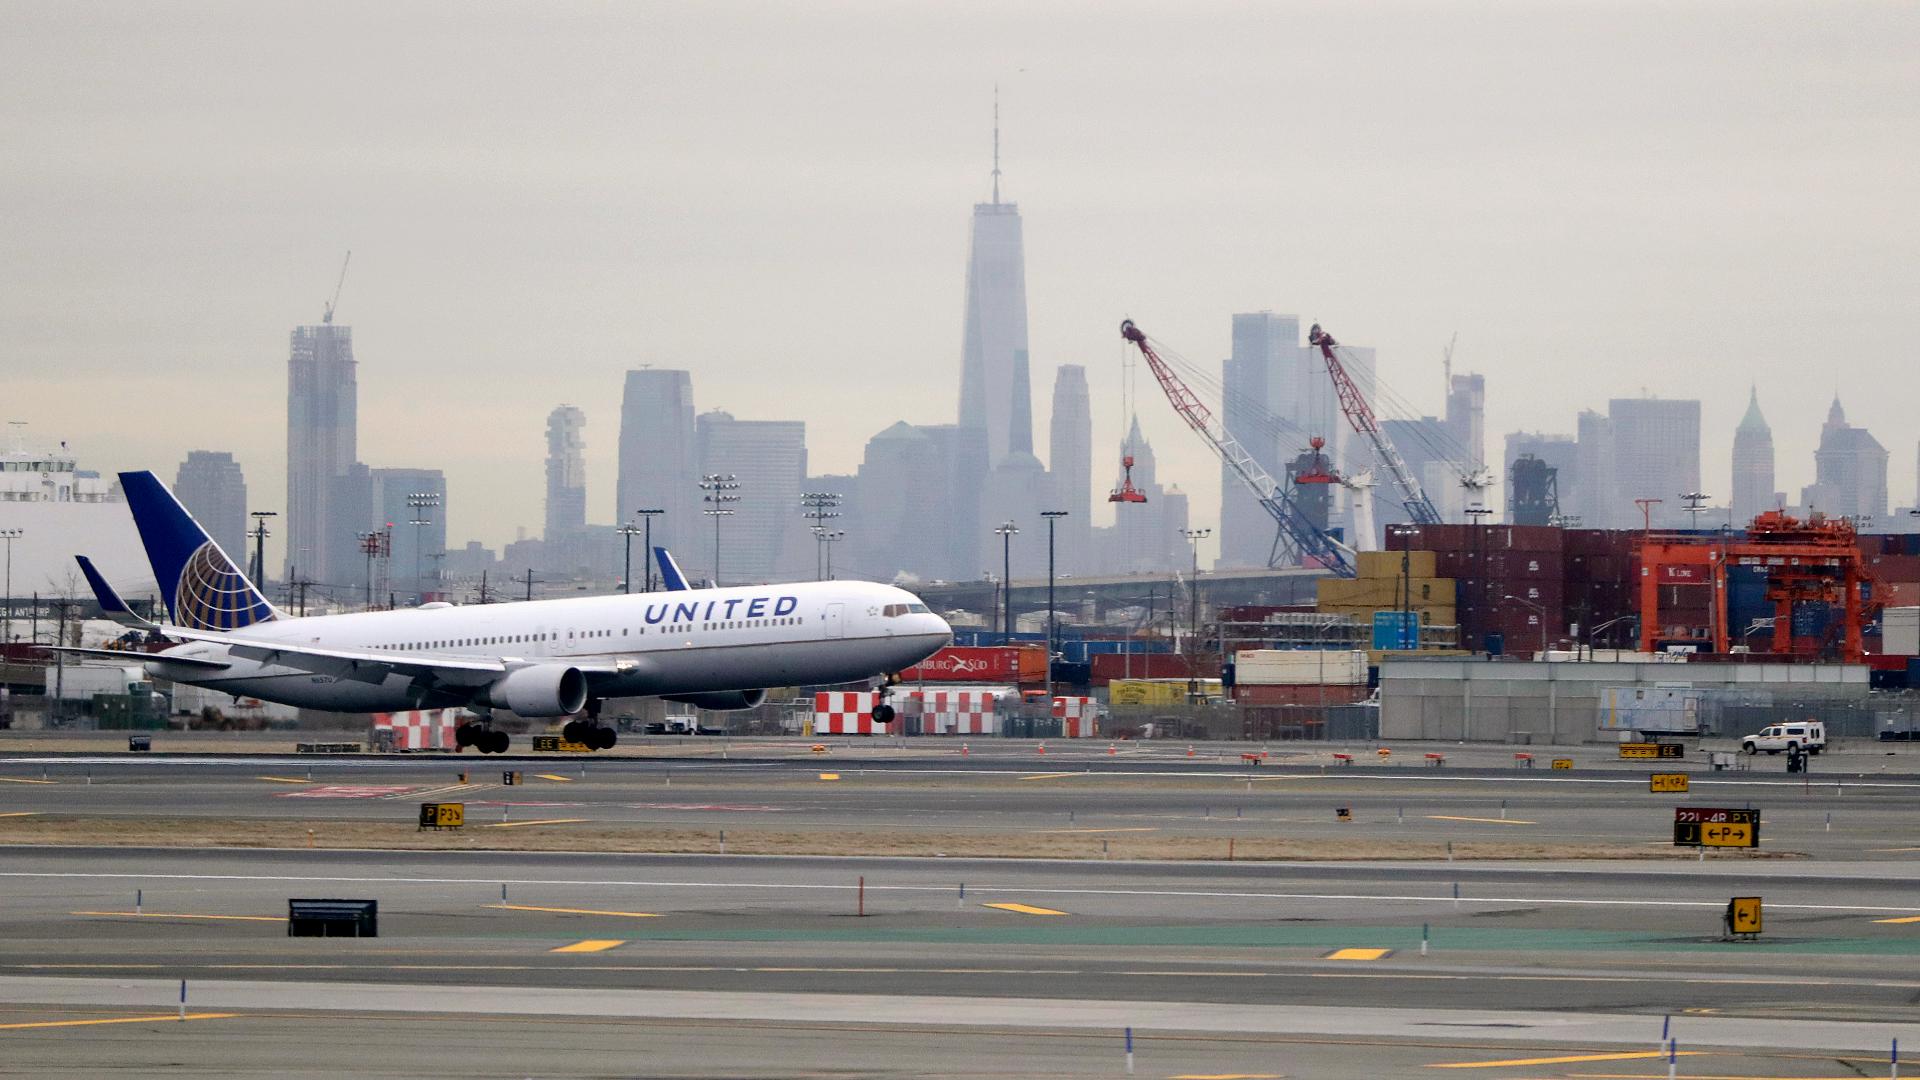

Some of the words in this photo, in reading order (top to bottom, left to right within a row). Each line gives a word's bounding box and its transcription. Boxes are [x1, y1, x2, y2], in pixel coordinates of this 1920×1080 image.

[645, 596, 798, 625] UNITED
[428, 808, 434, 821] P
[441, 808, 454, 822] P3
[1684, 826, 1694, 841] J
[1721, 827, 1732, 841] P
[1749, 903, 1758, 925] J
